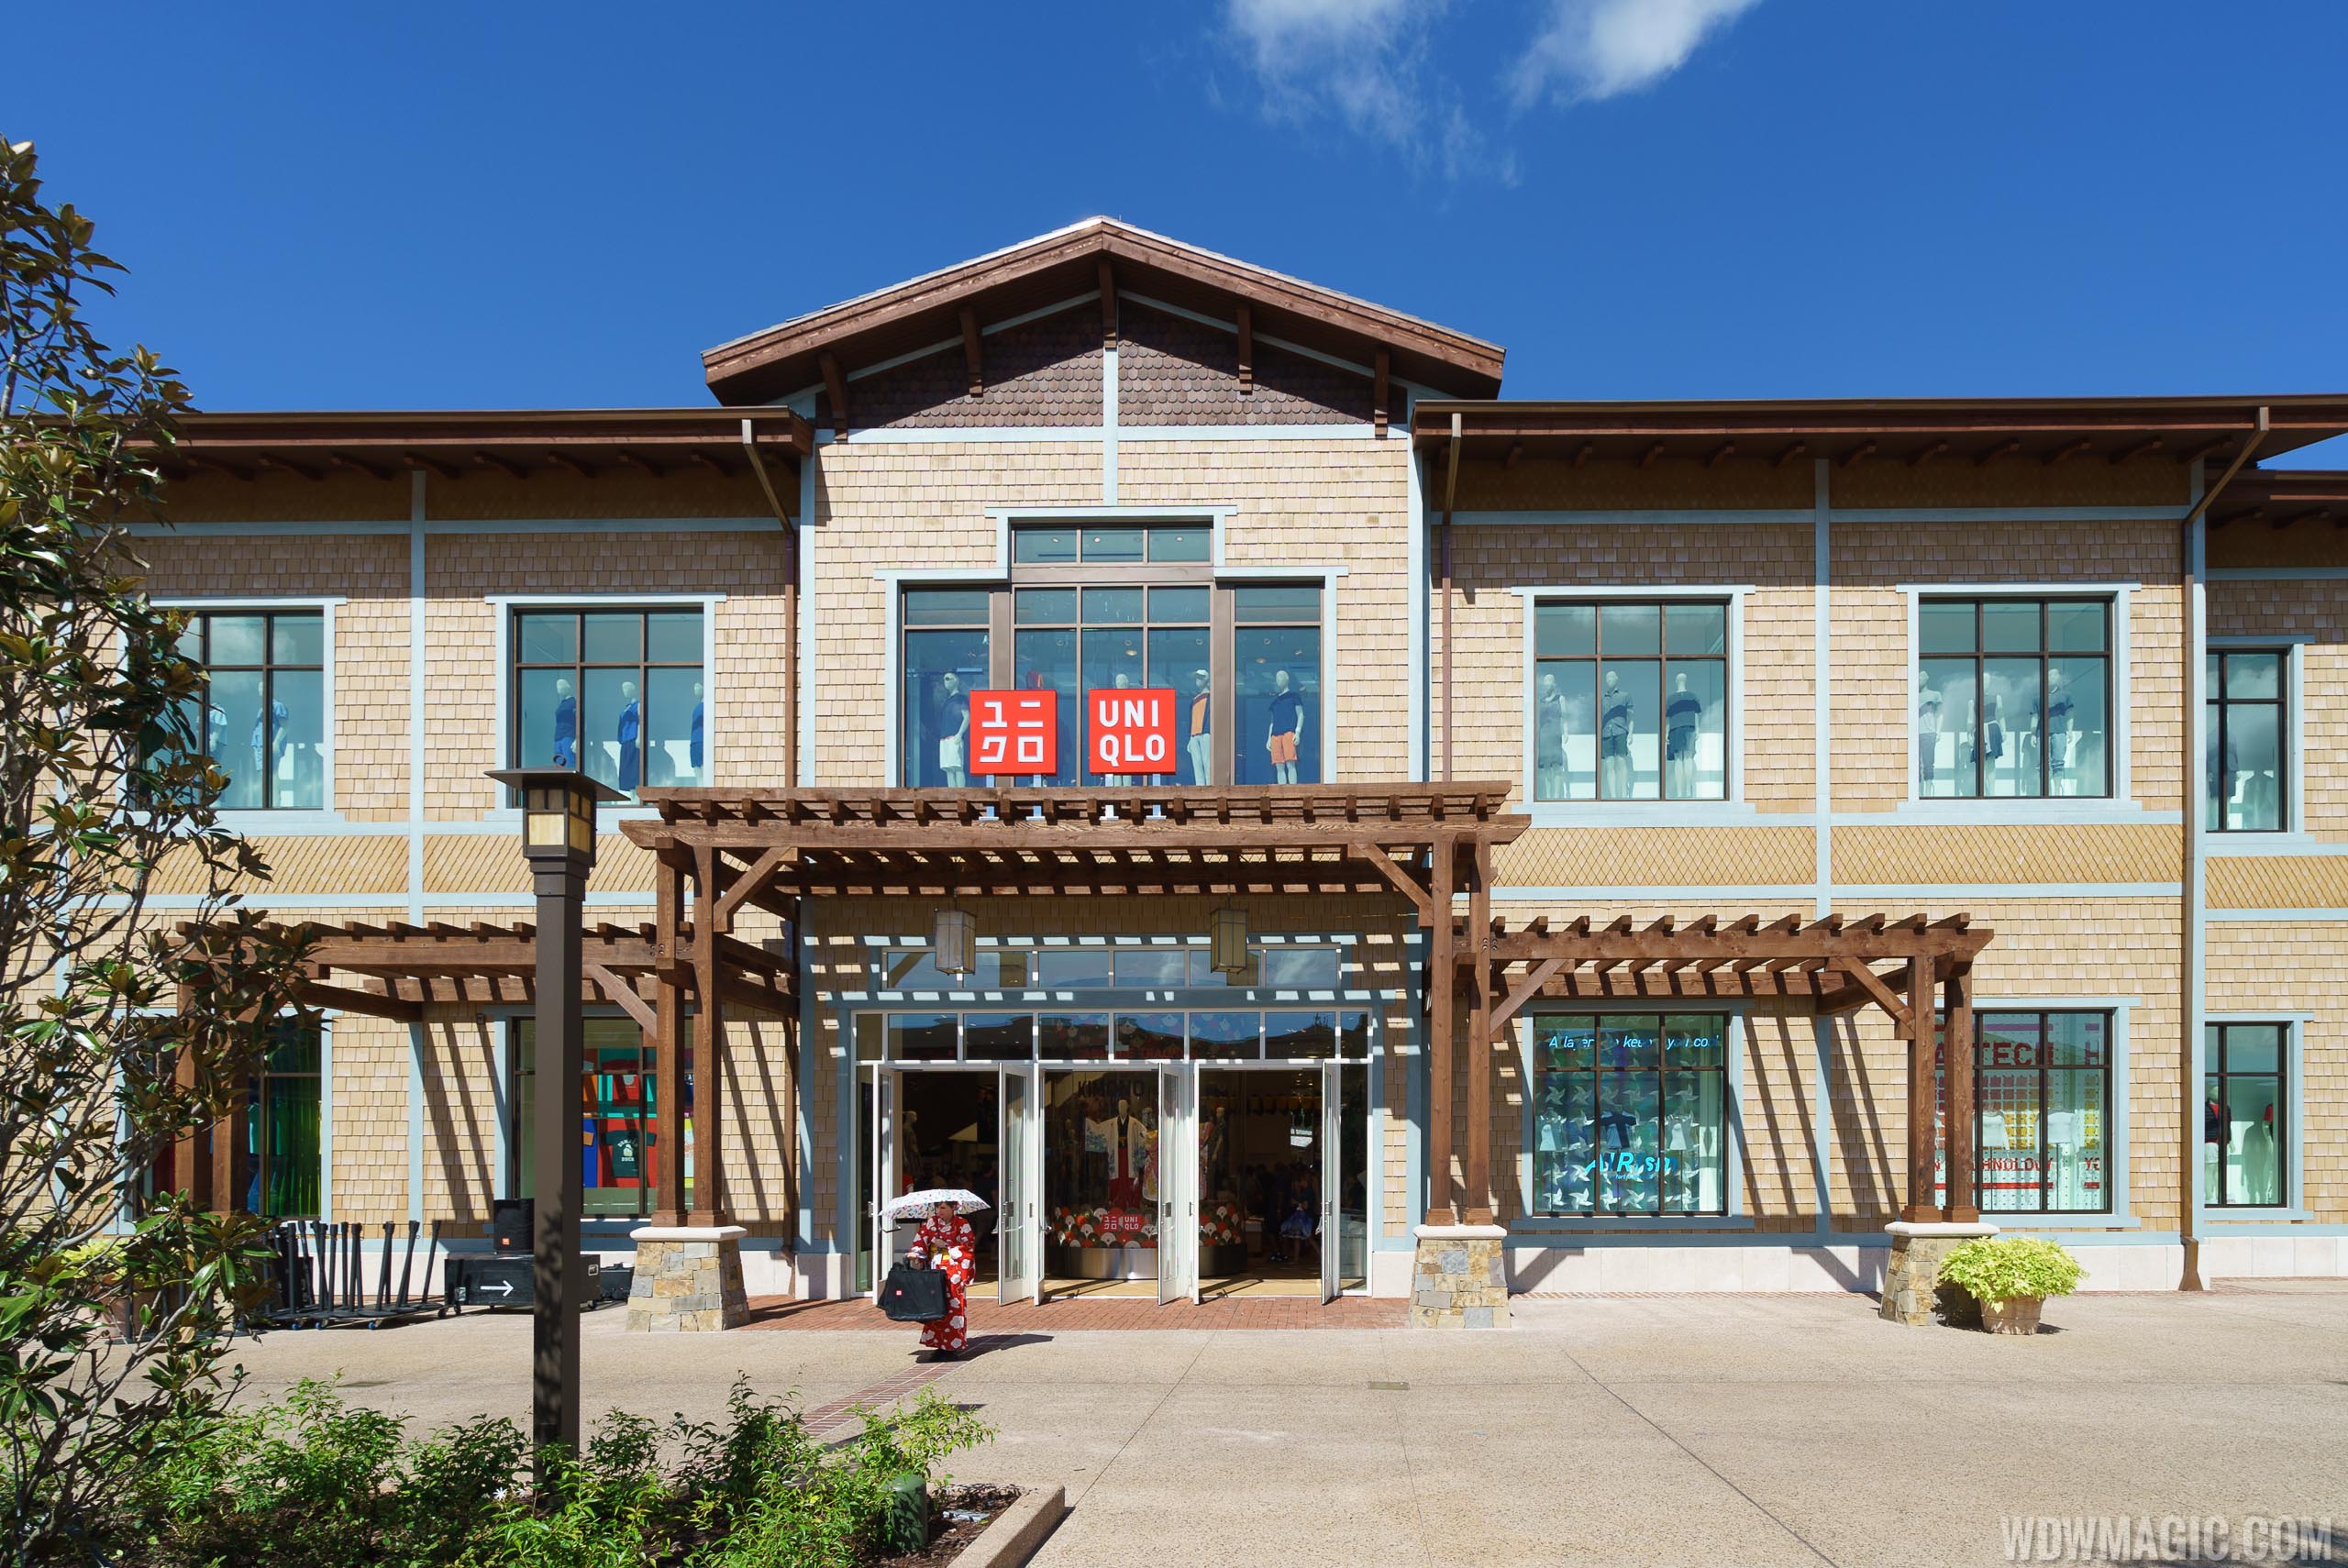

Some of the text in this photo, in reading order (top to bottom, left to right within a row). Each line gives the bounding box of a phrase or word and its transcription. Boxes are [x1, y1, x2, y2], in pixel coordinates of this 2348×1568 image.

[981, 701, 1044, 728] ユニ
[1099, 700, 1159, 728] UNI
[980, 735, 1044, 763] クロ
[1099, 734, 1166, 767] QLO
[1548, 1036, 1558, 1048] A
